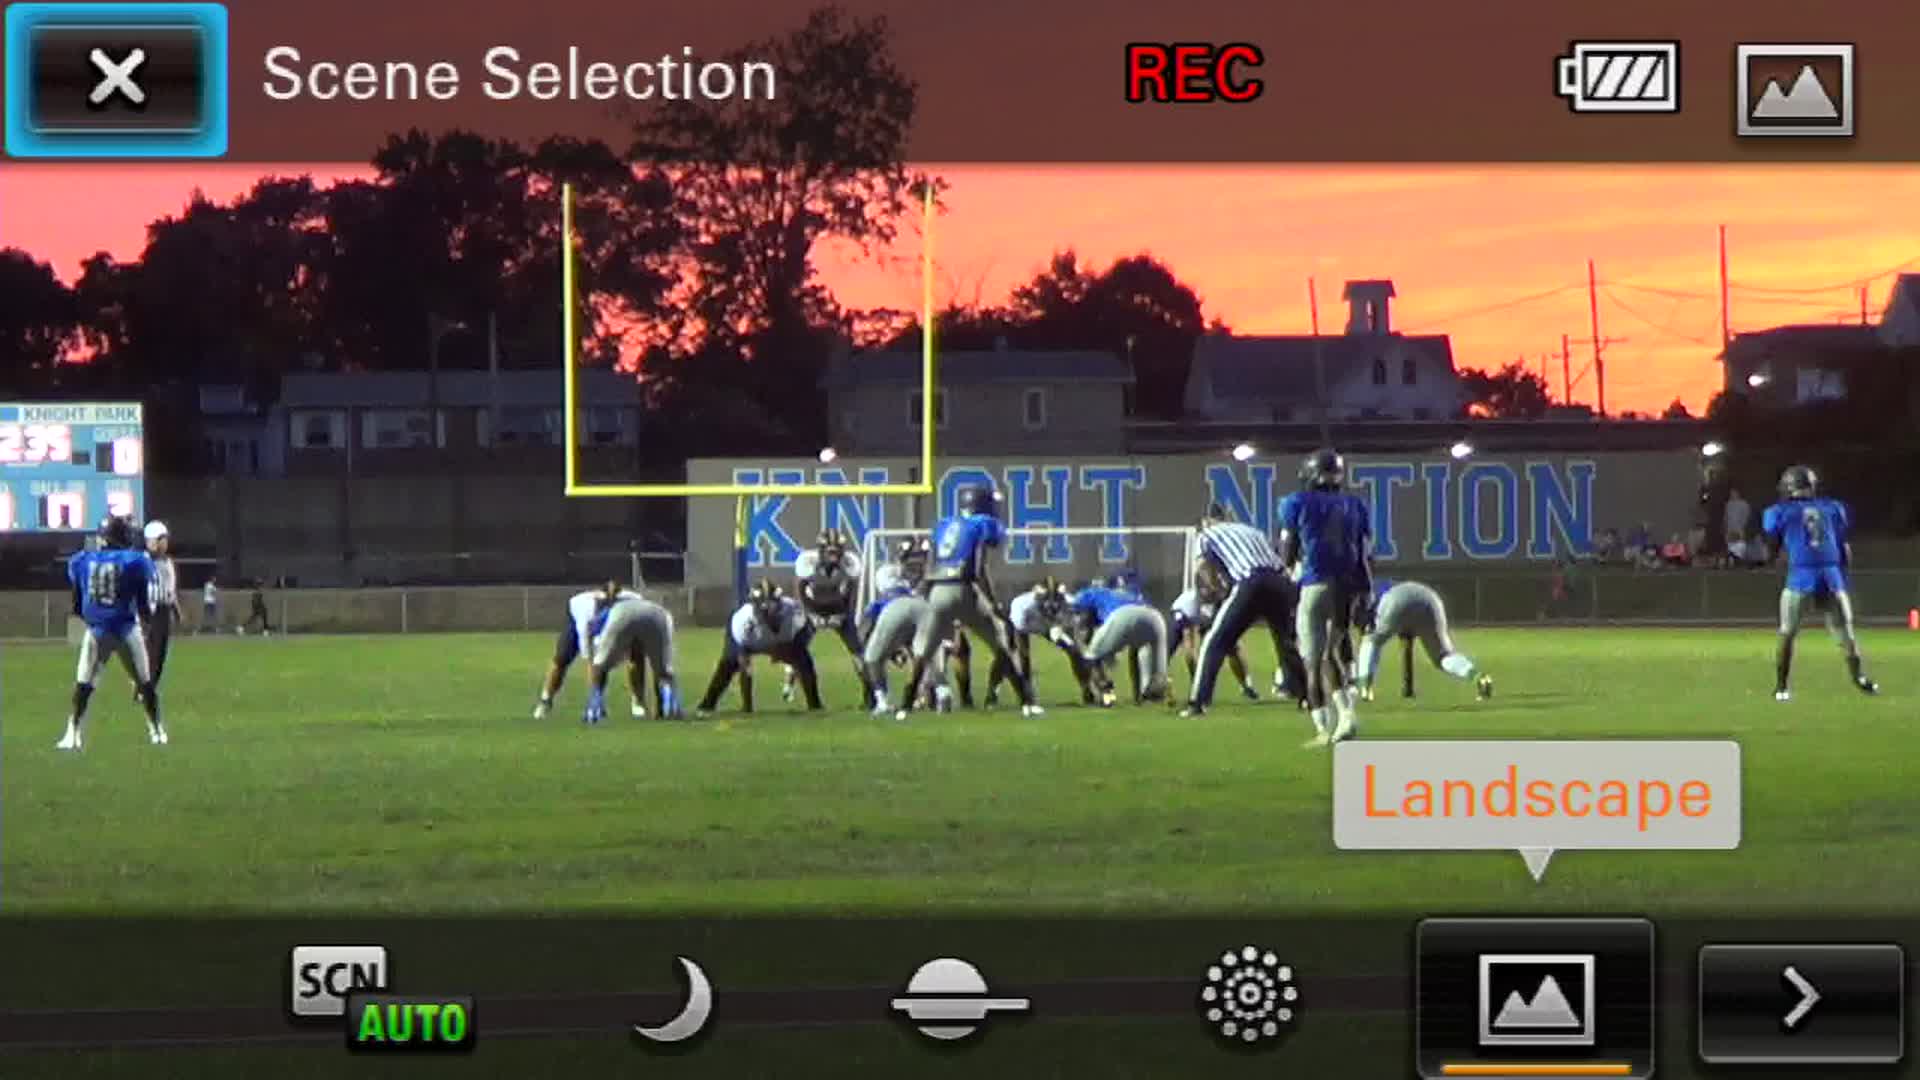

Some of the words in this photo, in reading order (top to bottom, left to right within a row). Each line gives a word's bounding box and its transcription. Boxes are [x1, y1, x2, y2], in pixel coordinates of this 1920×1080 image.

[24, 407, 86, 421] KNIGHT
[97, 407, 139, 421] PARK
[733, 467, 1147, 567] KNHT
[1204, 463, 1597, 560] NTION
